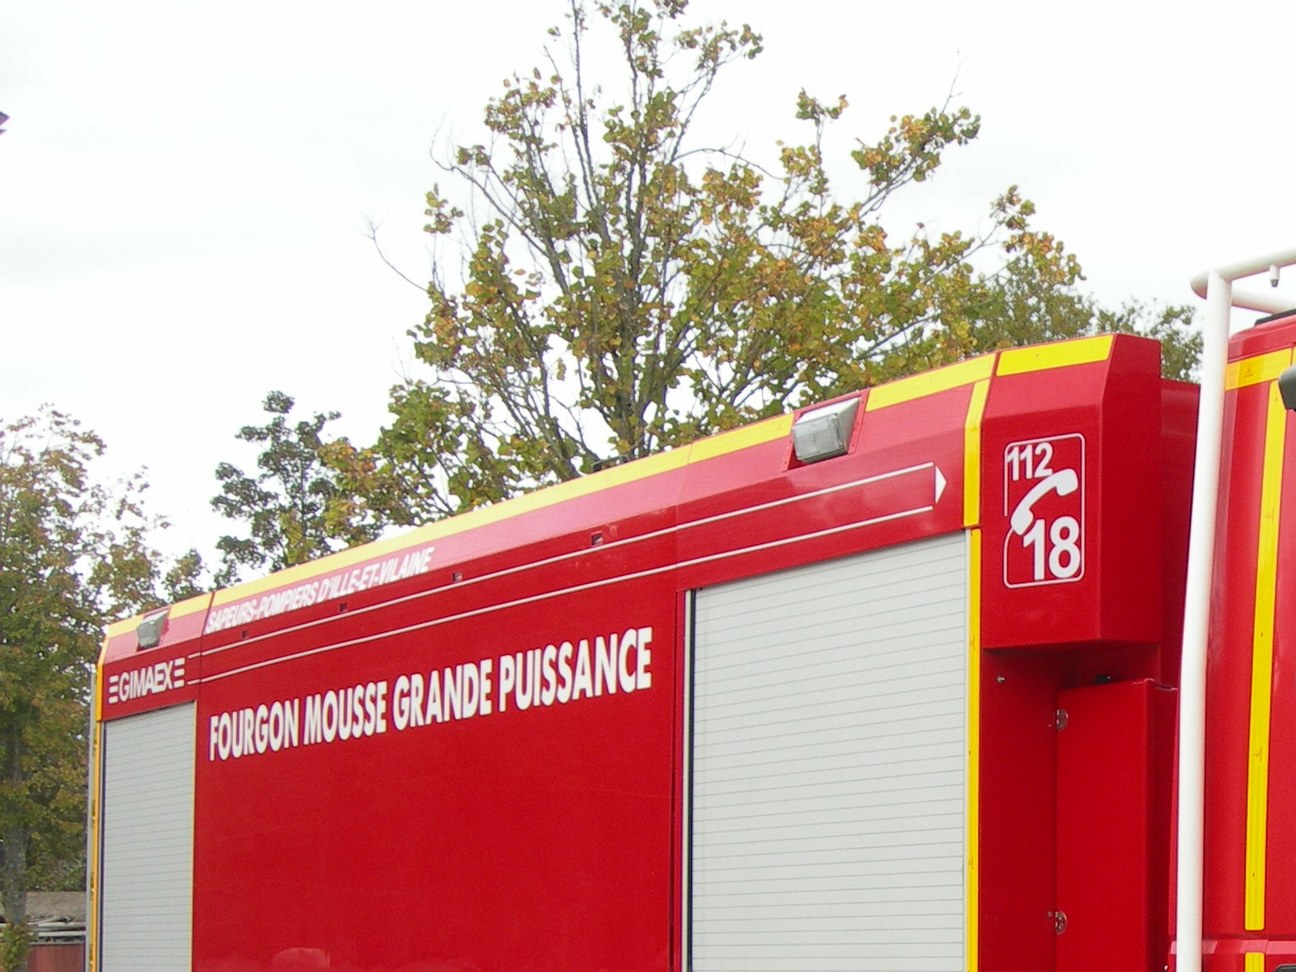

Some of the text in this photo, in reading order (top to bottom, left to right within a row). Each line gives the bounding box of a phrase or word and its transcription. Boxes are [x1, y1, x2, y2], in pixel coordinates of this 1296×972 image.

[1007, 441, 1053, 481] 112
[1023, 515, 1081, 581] 18
[203, 581, 319, 635] SAPEURS-POMPIERS
[208, 626, 653, 761] FOURGON MOUSSE GRANDE PUISSANCE
